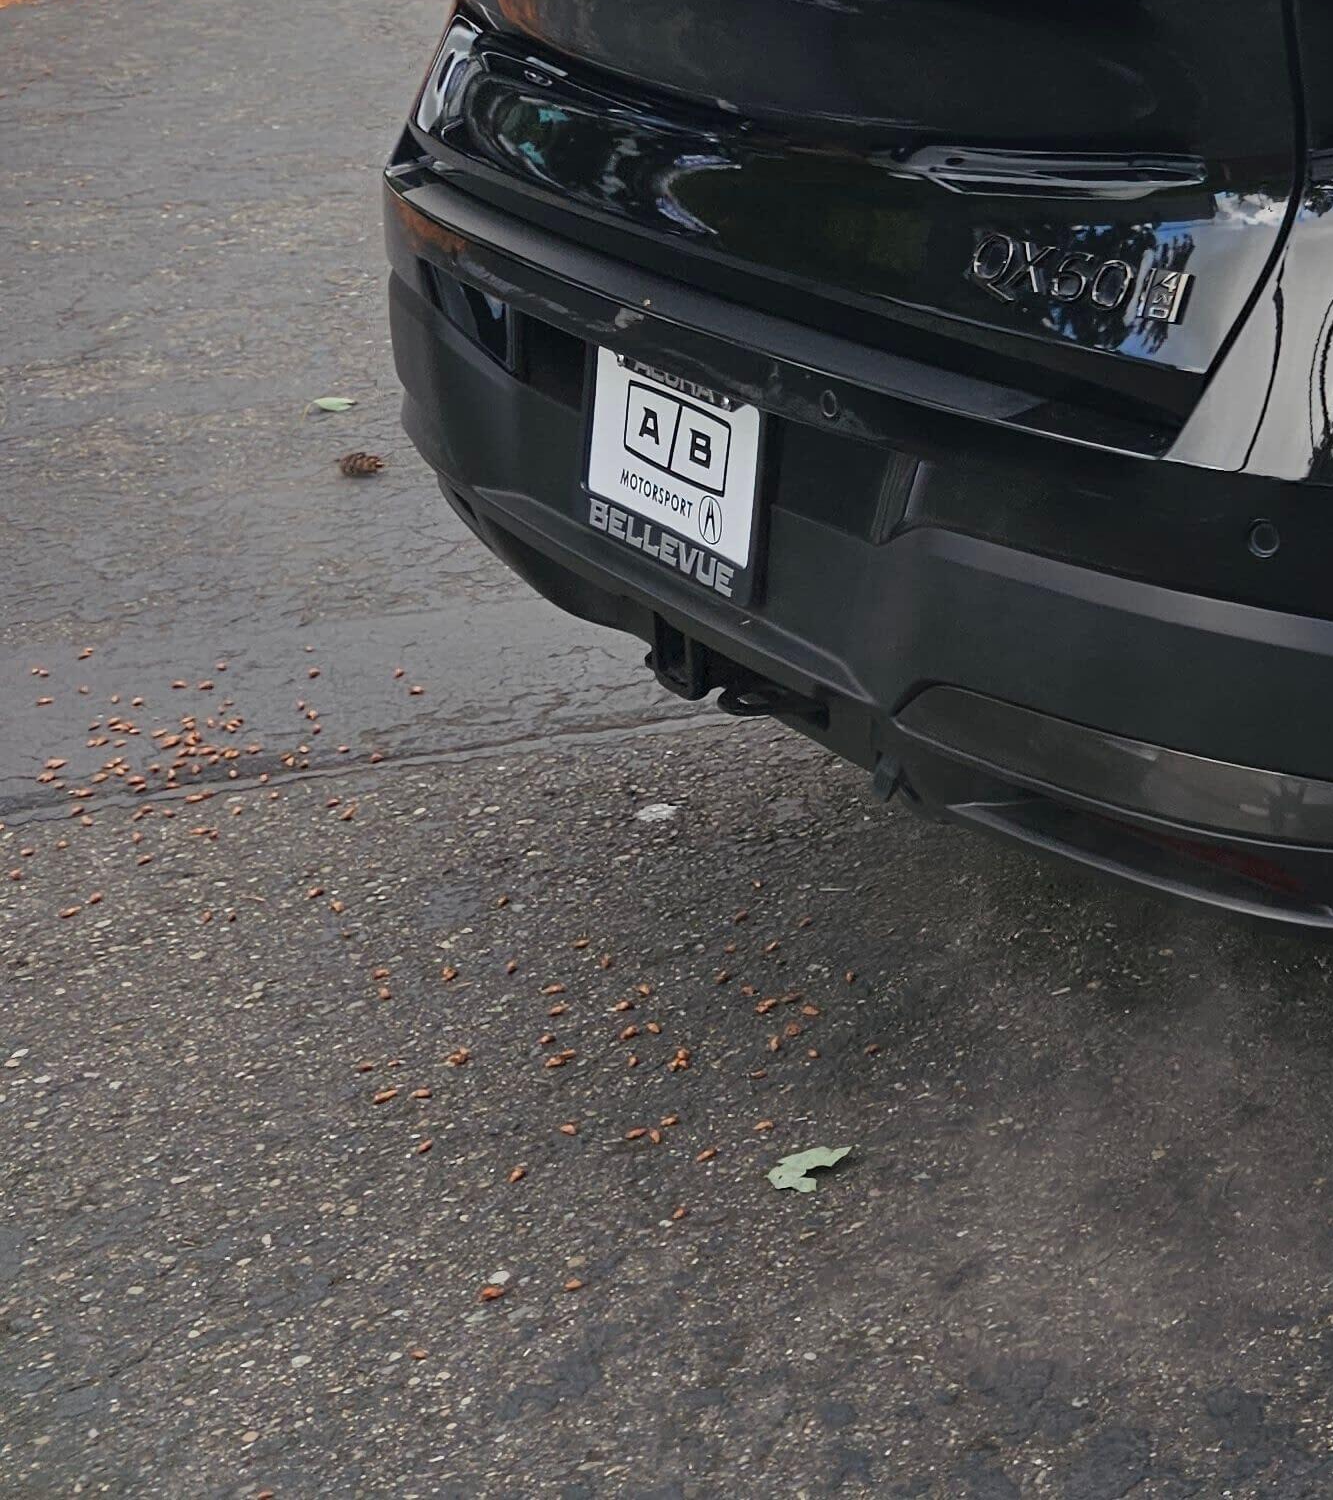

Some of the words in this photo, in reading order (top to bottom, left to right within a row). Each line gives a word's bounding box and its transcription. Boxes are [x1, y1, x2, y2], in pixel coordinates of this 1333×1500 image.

[973, 232, 1133, 310] QX60
[638, 406, 660, 446] A
[689, 427, 712, 470] B
[619, 468, 694, 519] MOTORSPORT
[589, 497, 735, 598] BELLEVUE
